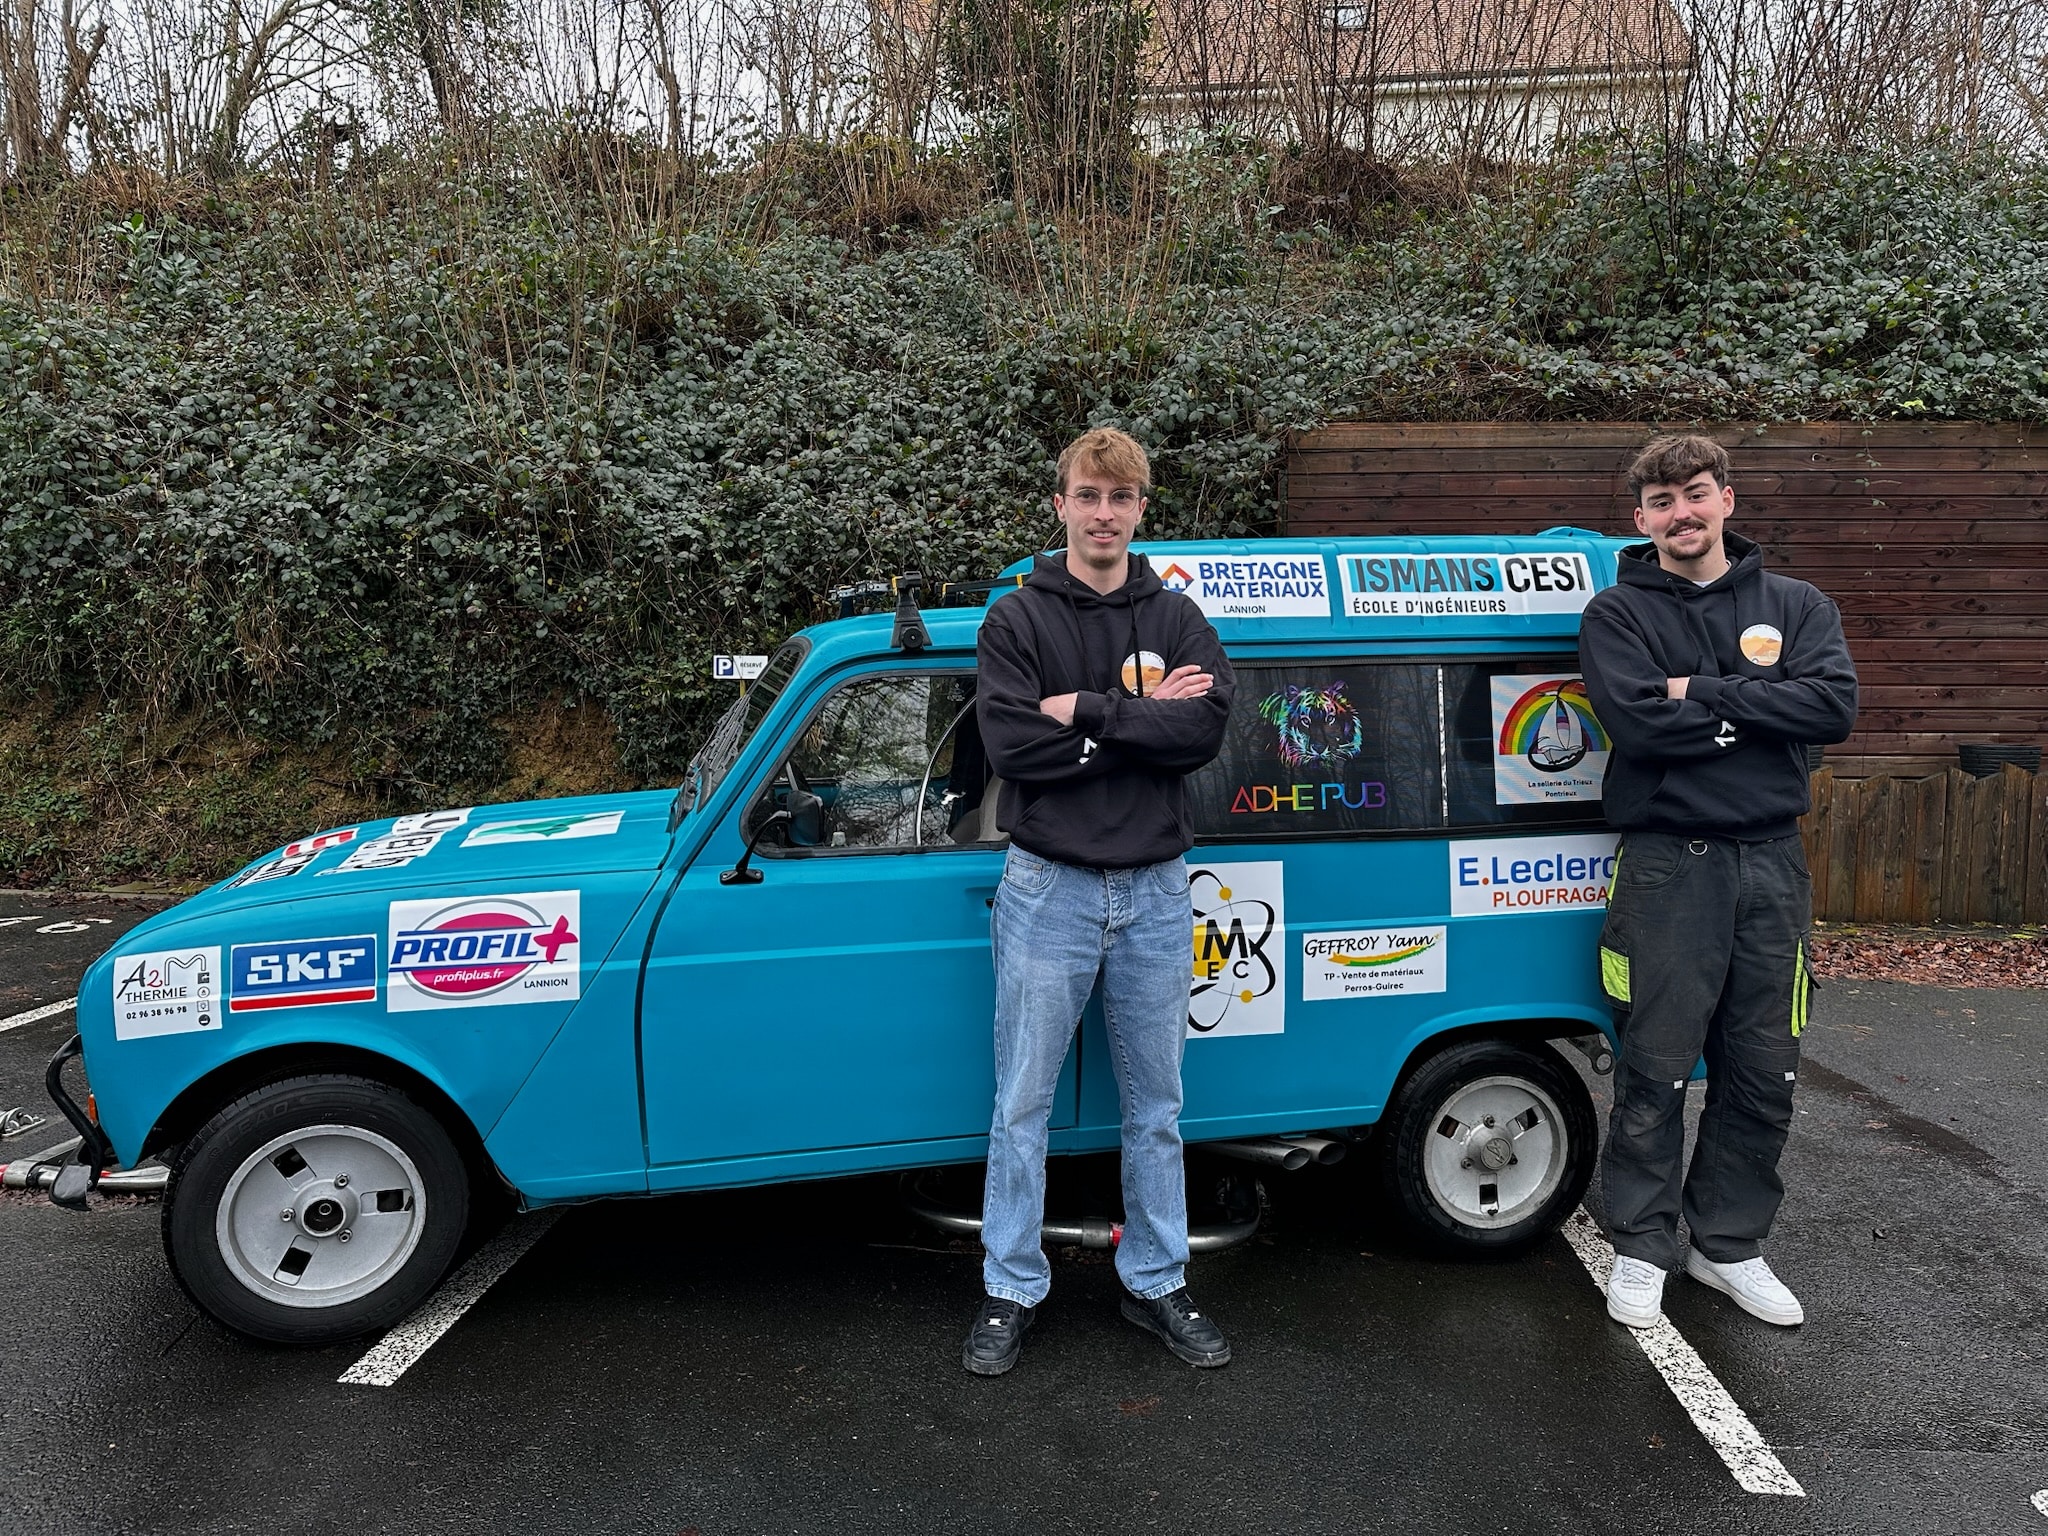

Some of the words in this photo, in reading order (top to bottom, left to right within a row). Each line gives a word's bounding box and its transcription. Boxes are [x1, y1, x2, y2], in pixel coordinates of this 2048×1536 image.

[1199, 562, 1322, 580] BRETAGNE
[1354, 557, 1495, 592] ISMANS
[1504, 556, 1586, 593] CESI
[1203, 581, 1325, 598] MATERIAUX
[1223, 605, 1266, 613] LANNION
[1353, 598, 1398, 614] ÉCOLE
[1406, 598, 1507, 614] D'INGÉNIEURS
[1231, 784, 1315, 813] ADHE
[1321, 782, 1386, 810] PUB
[1493, 886, 1608, 907] PLOUFRAGA
[1304, 936, 1379, 958] GEFFROY
[1387, 934, 1435, 949] Yann
[246, 948, 366, 986] SKF
[1325, 973, 1335, 981] TP
[1342, 971, 1367, 980] Vente
[1368, 970, 1379, 978] de
[1381, 968, 1424, 977] matériaux
[433, 969, 504, 986] profilplus.fr
[524, 978, 568, 989] LANNION
[125, 986, 187, 1002] THERMIE
[1345, 982, 1404, 992] Perros-Guirec
[126, 1012, 136, 1020] 02
[139, 1010, 149, 1018] 96
[151, 1009, 161, 1017] 38
[164, 1007, 174, 1015] 96
[176, 1006, 187, 1014] 98
